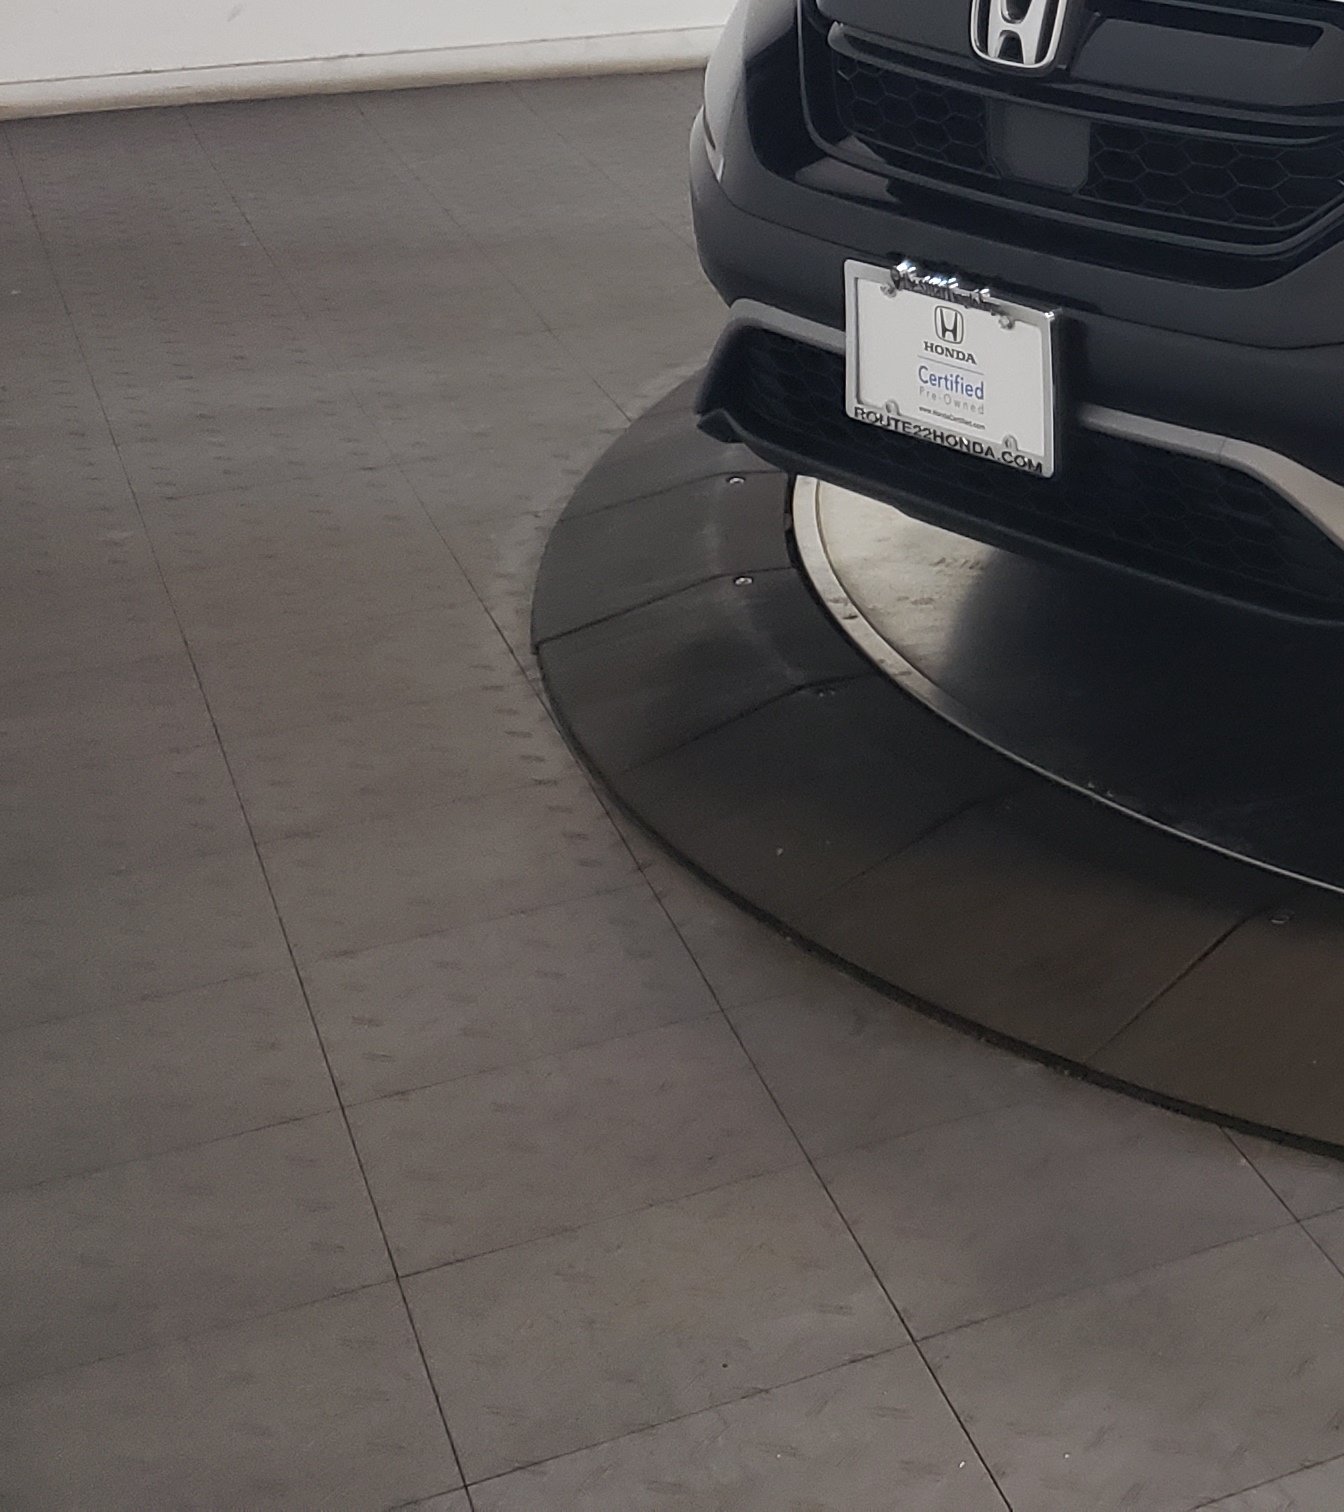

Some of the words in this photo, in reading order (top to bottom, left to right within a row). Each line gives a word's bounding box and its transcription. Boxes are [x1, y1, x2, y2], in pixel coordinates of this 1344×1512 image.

[923, 340, 977, 365] HONDA
[918, 365, 984, 400] Certified
[919, 386, 984, 415] Pre-Owned
[854, 406, 1044, 474] ROUTE22HONDA.COM
